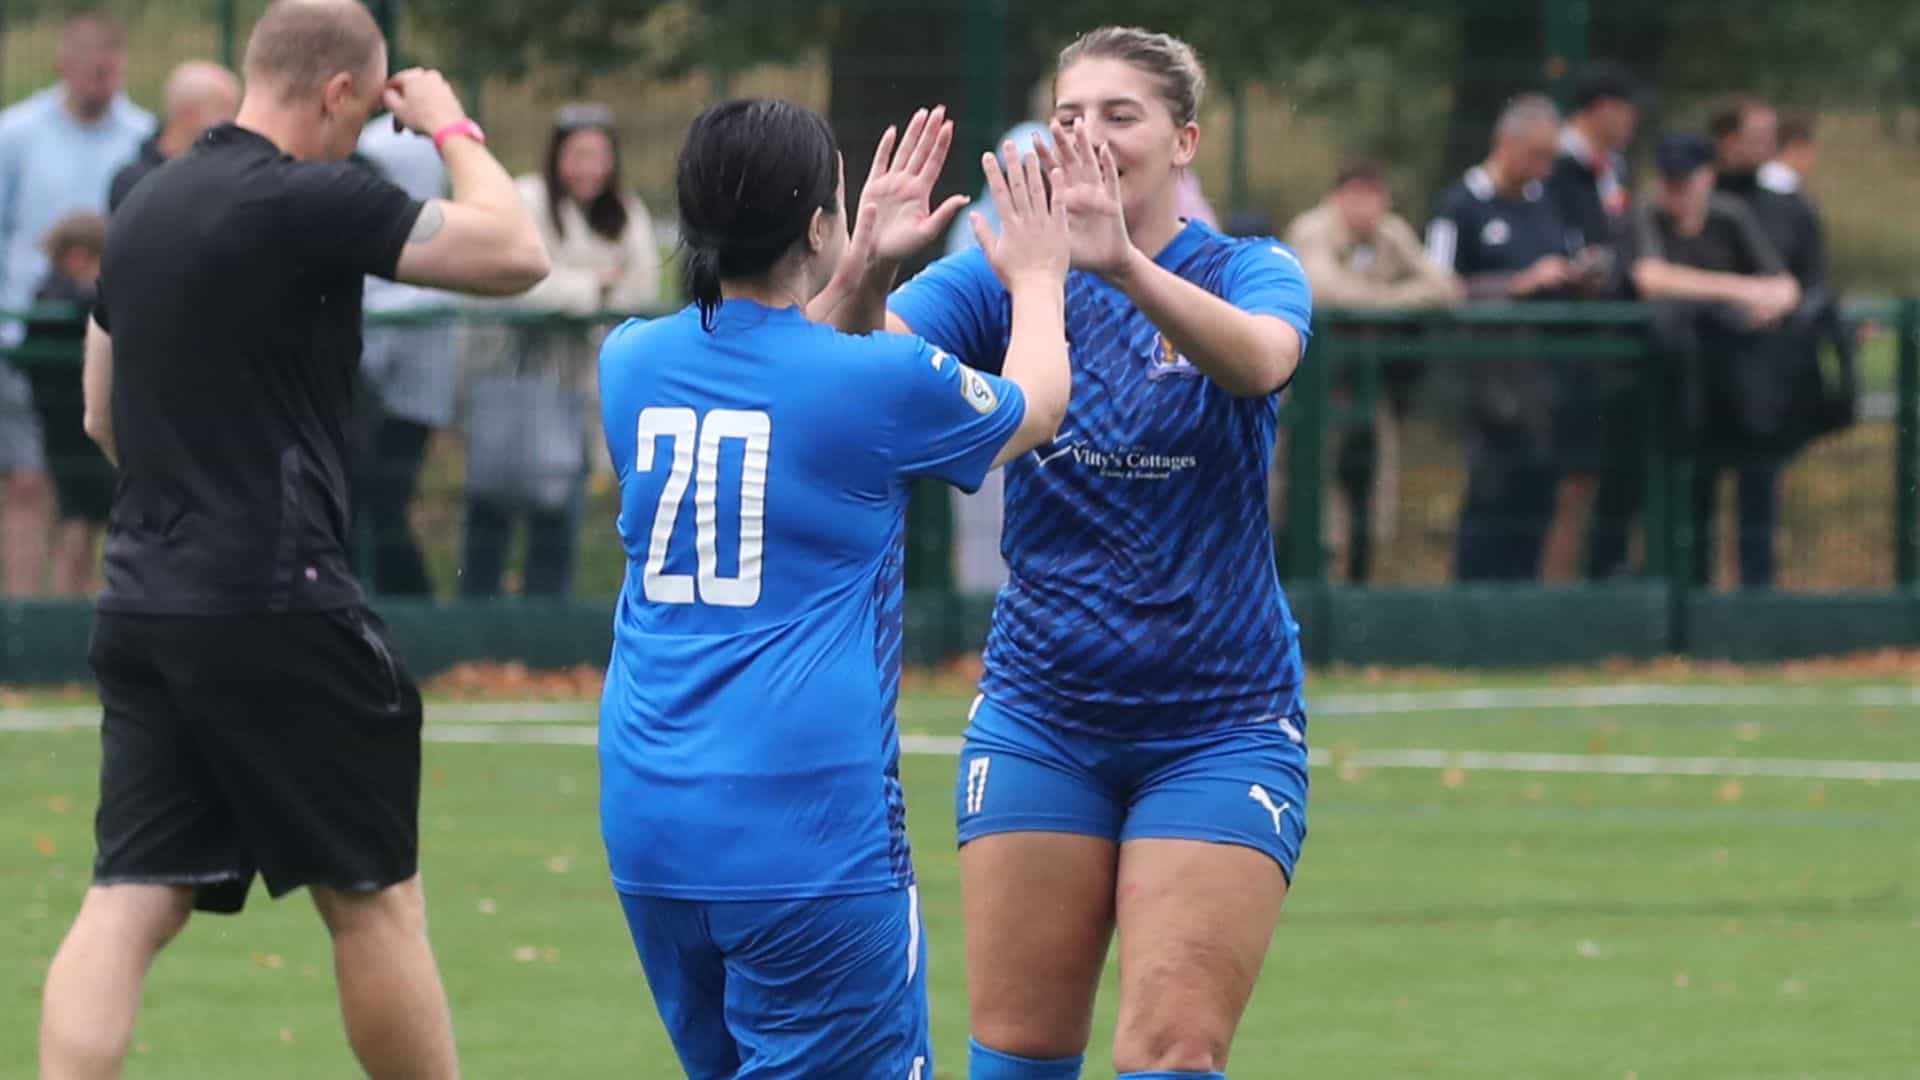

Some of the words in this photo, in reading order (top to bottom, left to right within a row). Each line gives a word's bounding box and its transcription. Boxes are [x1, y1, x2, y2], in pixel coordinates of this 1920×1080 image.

[1126, 453, 1196, 471] Cottages
[636, 407, 771, 607] 20
[968, 756, 990, 814] 17
